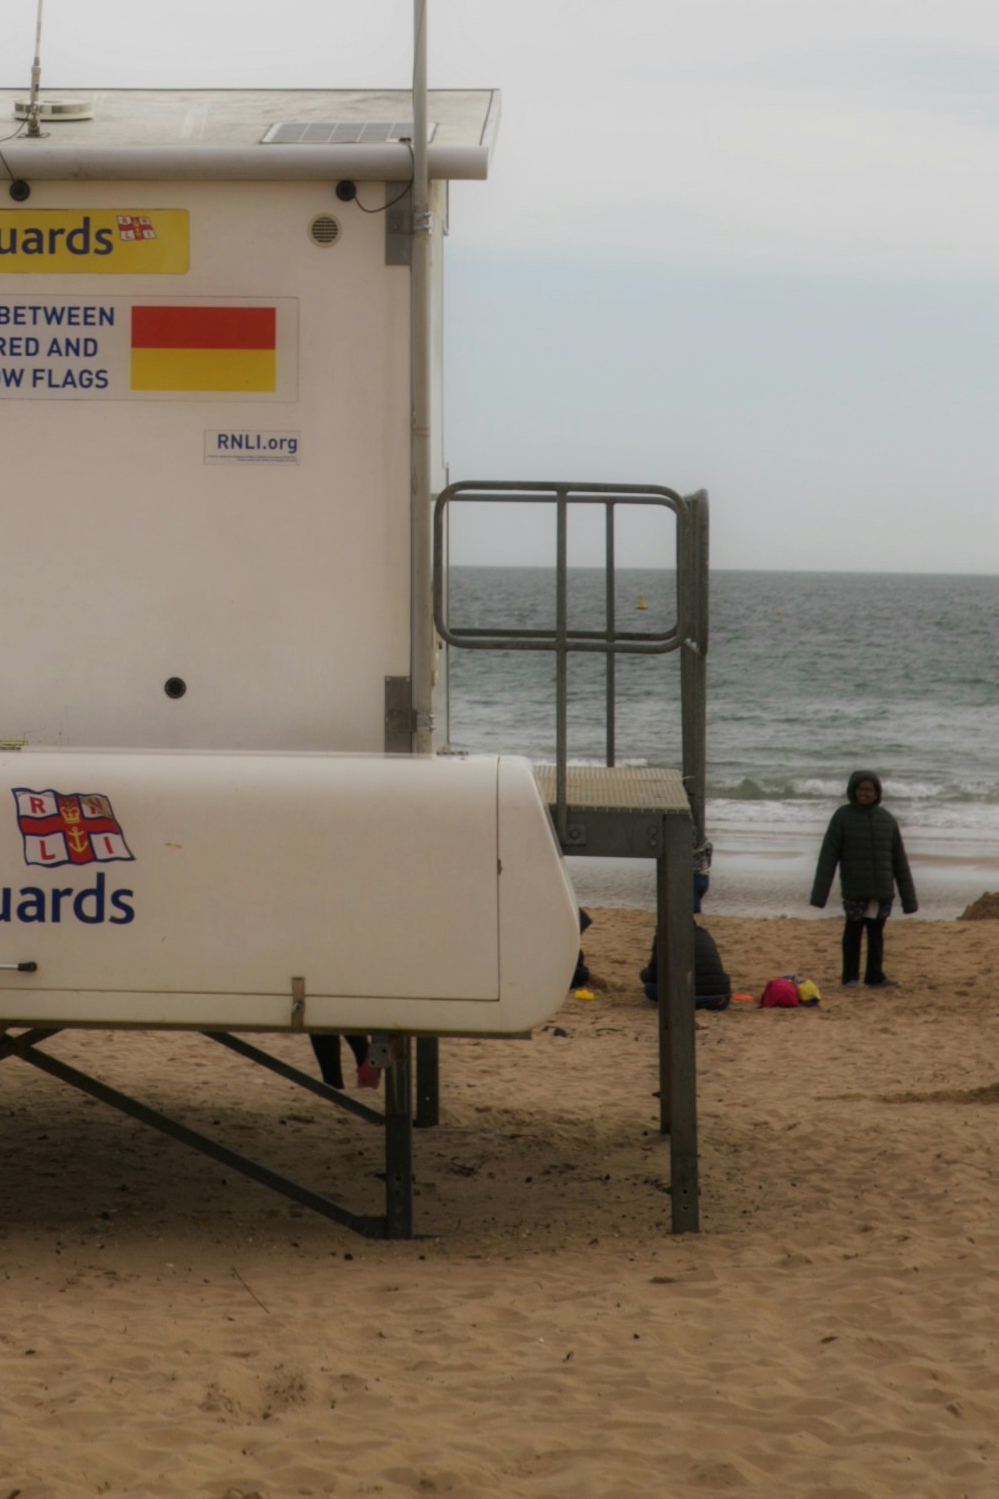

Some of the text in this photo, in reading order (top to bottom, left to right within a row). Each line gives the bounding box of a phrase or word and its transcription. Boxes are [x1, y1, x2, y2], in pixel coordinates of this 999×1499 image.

[47, 337, 98, 358] AND
[32, 368, 109, 389] FLAGS
[217, 433, 297, 454] RNLI.org
[30, 796, 46, 814] R
[39, 837, 114, 860] L I
